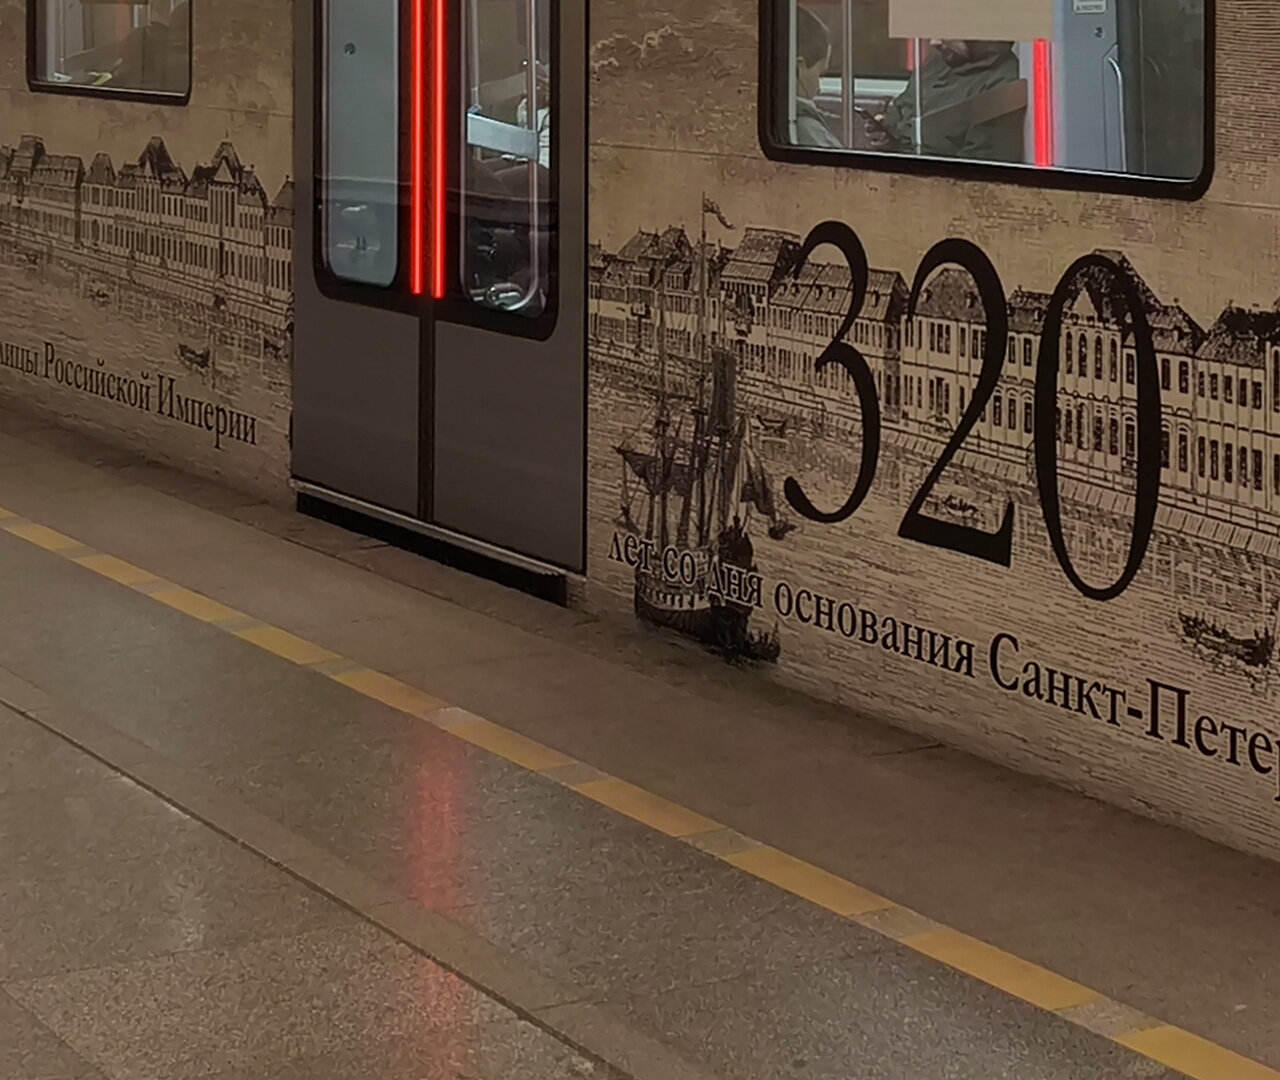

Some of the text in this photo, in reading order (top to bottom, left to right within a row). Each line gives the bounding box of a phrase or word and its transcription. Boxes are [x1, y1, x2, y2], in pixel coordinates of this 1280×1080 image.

[42, 341, 152, 414] Российской
[156, 373, 258, 450] Империи
[783, 220, 1162, 602] 320
[607, 530, 655, 572] лет
[662, 547, 697, 586] со
[706, 556, 764, 609] дня
[774, 581, 976, 678] основания
